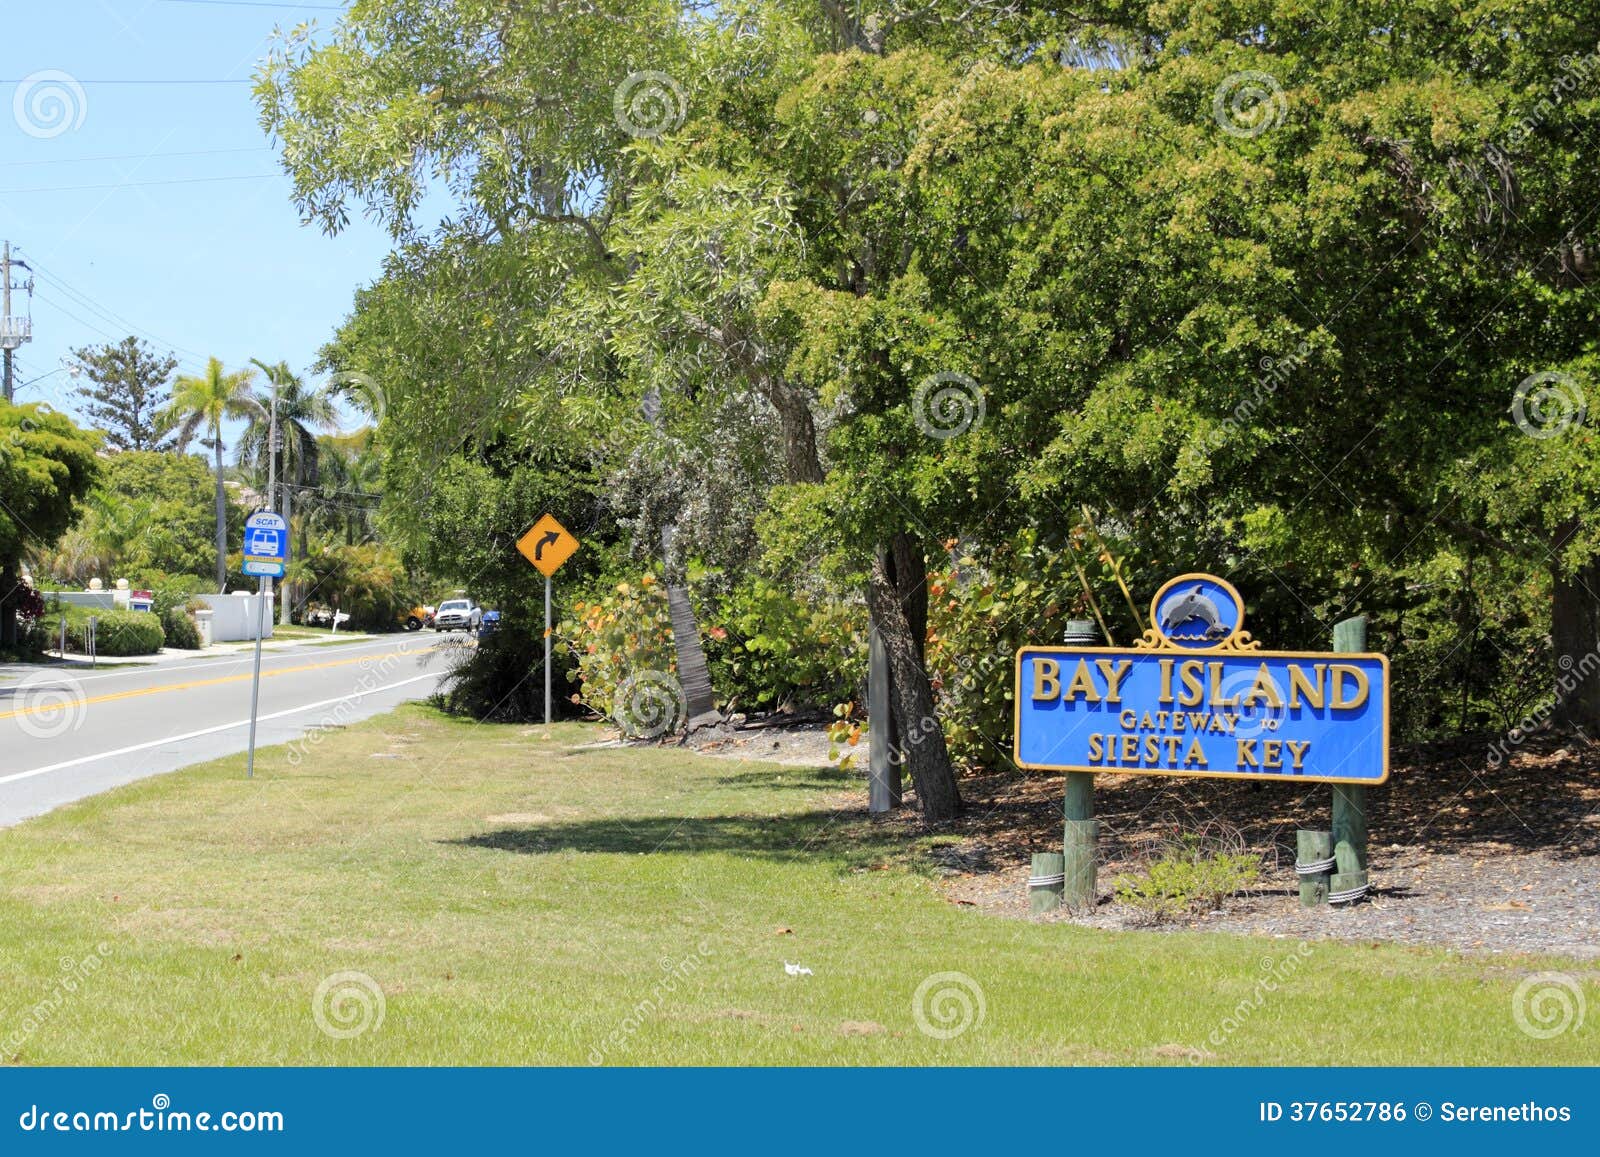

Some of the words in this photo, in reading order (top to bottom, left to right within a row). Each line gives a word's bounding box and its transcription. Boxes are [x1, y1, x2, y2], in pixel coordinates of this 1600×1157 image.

[255, 518, 279, 526] SCAT
[1032, 657, 1132, 702] BAY
[1158, 659, 1370, 709] ISLAND
[1120, 709, 1240, 733] GATEWAY
[1260, 718, 1279, 731] TO
[1088, 733, 1208, 765] SIESTA
[1236, 738, 1312, 768] KEY
